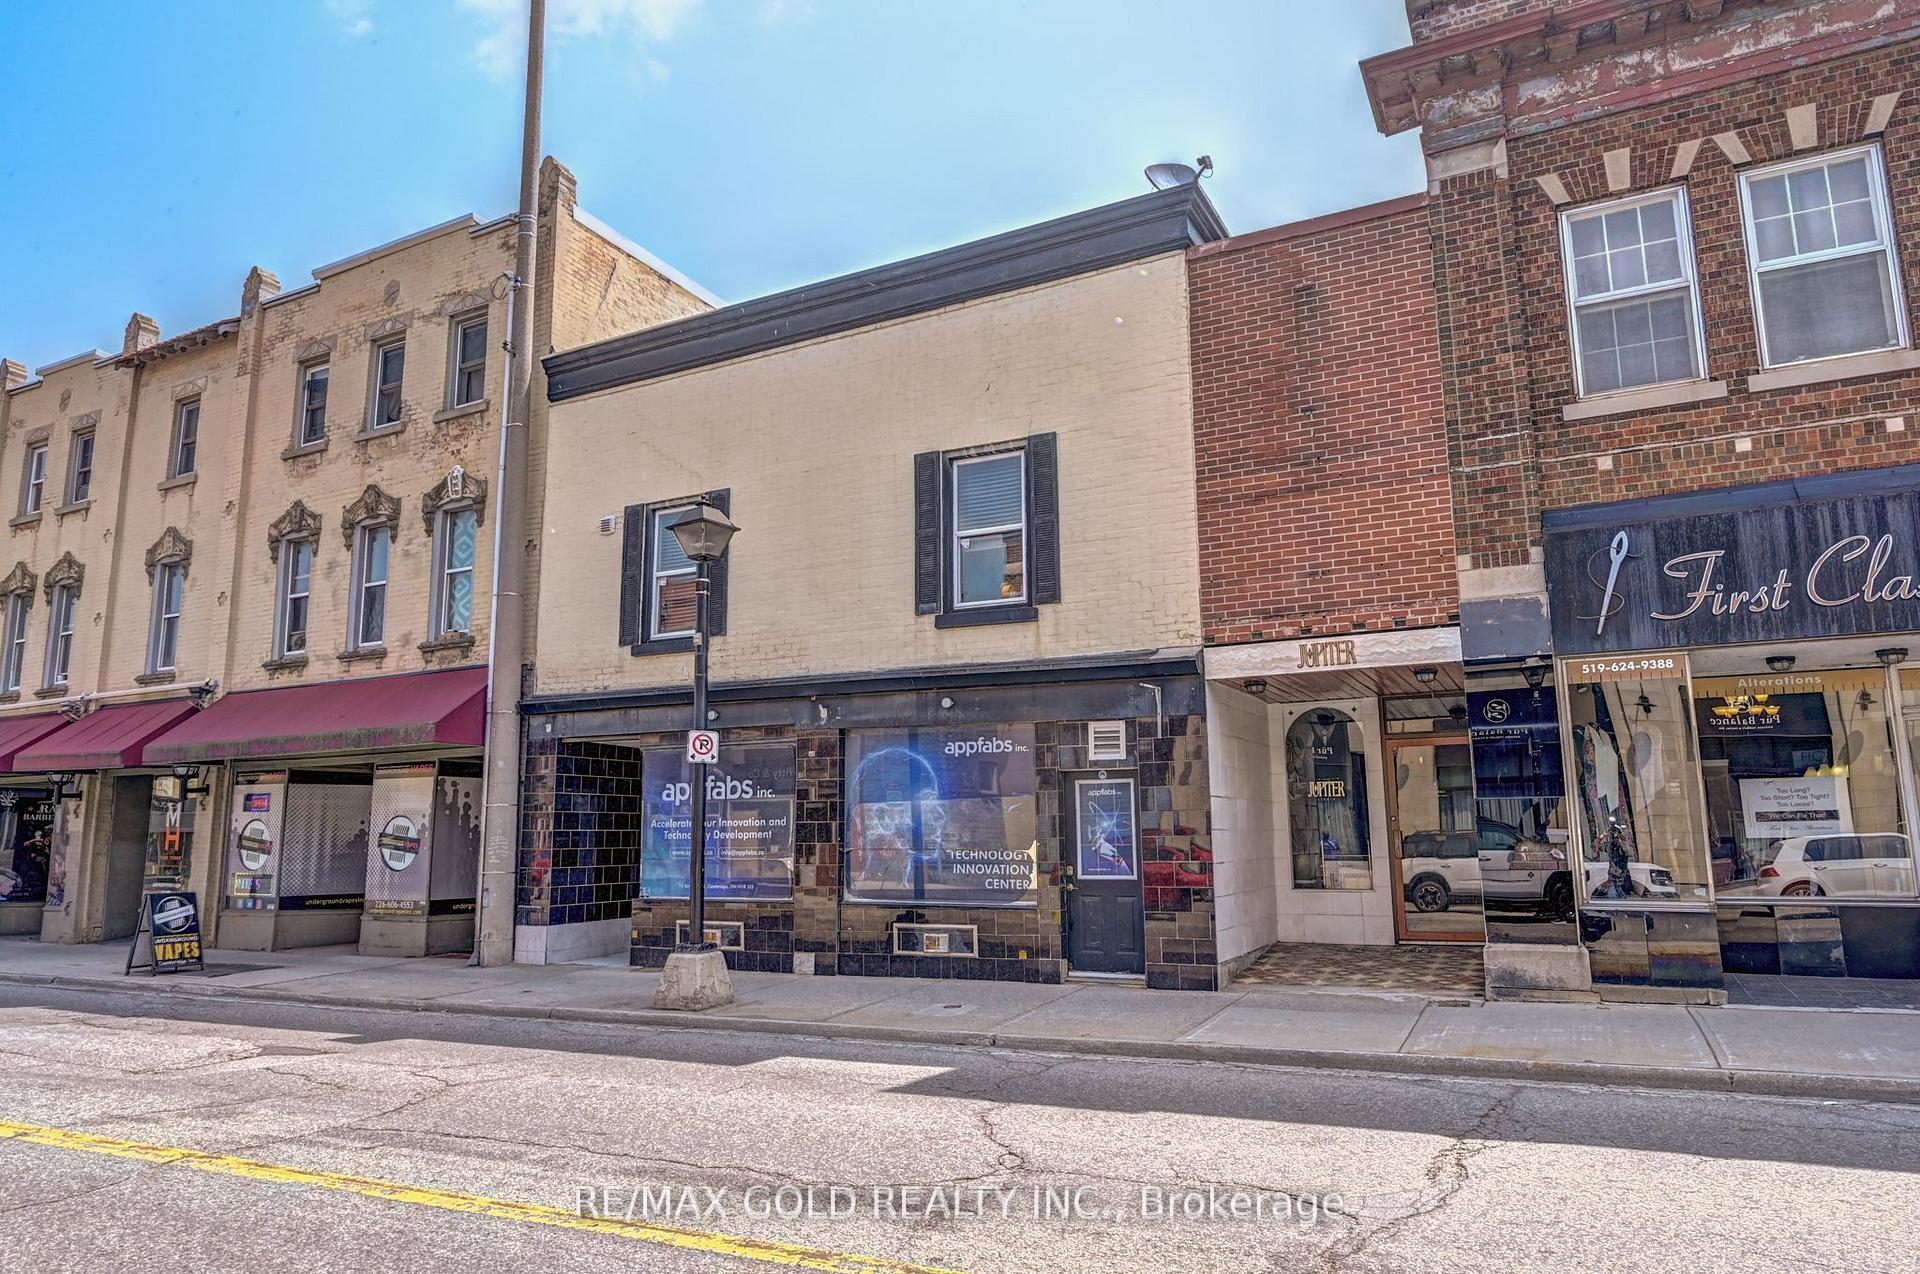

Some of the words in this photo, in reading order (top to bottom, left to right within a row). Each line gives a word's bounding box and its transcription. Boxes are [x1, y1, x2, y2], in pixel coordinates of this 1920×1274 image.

[1650, 550, 1792, 620] First
[1297, 639, 1357, 669] JUPITER
[1582, 658, 1674, 674] 519-624-9388
[1737, 674, 1822, 688] Alterations
[944, 736, 1013, 757] appfabs
[1015, 743, 1029, 752] inc.
[661, 775, 754, 806] apfabs
[756, 786, 776, 798] inc.
[1088, 788, 1117, 798] appfabs
[1308, 780, 1346, 798] JUPITER
[718, 816, 766, 827] Innovation
[769, 816, 787, 827] and
[713, 829, 772, 841] Development
[949, 850, 1030, 861] TECHNOLOGY
[952, 863, 1030, 875] INNOVATION
[985, 878, 1030, 890] CENTER
[154, 941, 200, 961] VAPES
